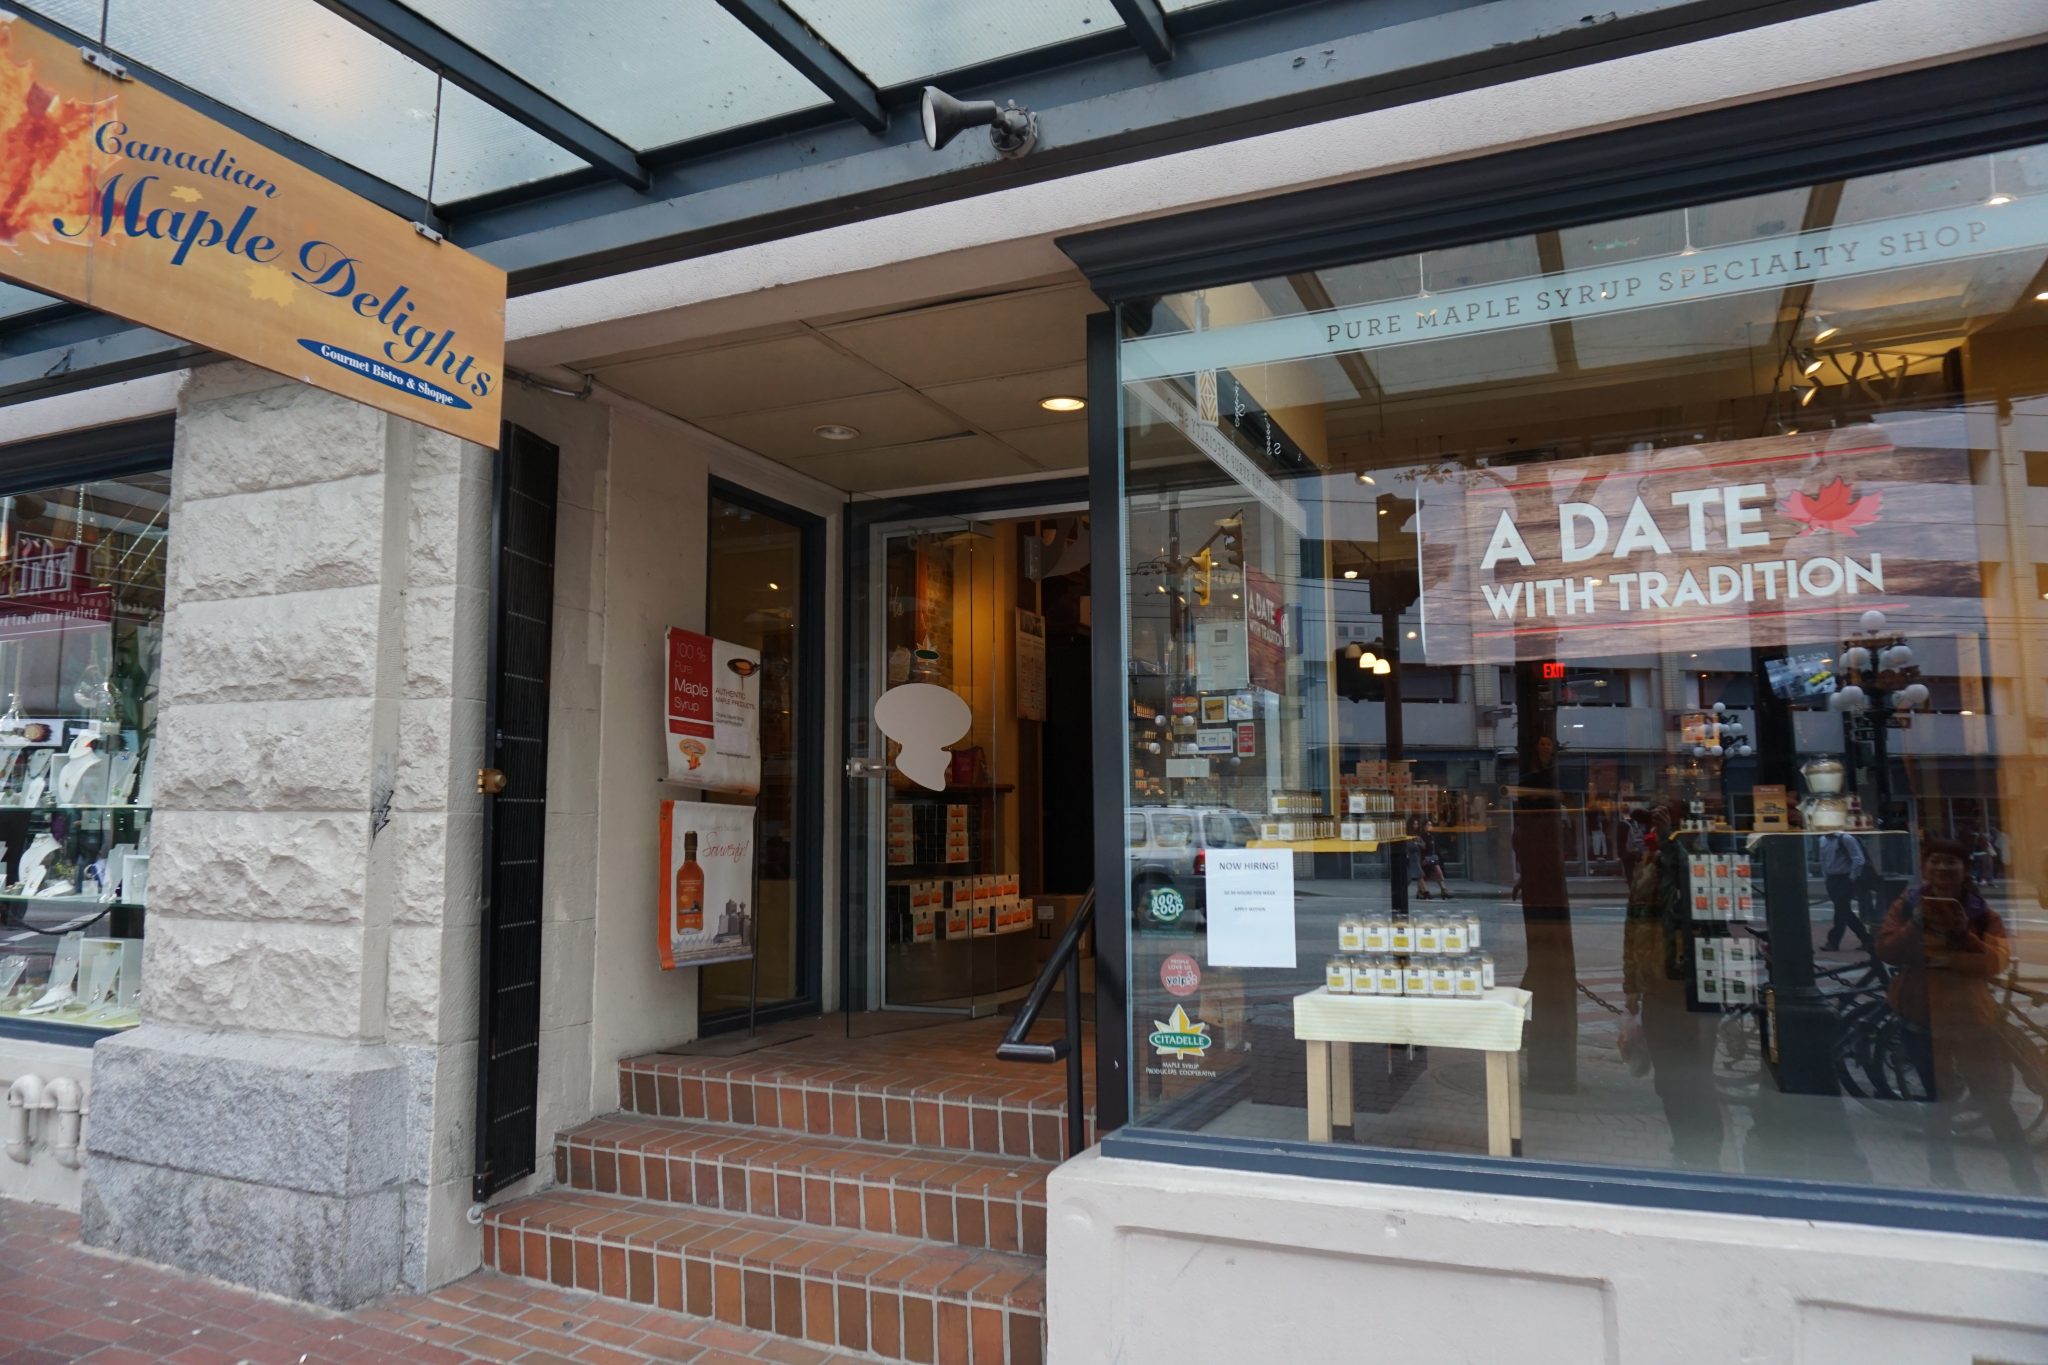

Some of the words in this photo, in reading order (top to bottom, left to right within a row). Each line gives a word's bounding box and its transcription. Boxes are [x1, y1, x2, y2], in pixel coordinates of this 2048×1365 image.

[95, 120, 282, 199] Canadian
[52, 172, 284, 266] Maple
[1327, 314, 1402, 343] PURE
[1415, 296, 1521, 330] MAPLE
[1536, 277, 1643, 312] SYRUP
[1658, 241, 1860, 292] SPECIALTY
[1879, 220, 1987, 257] SHOP
[290, 240, 498, 398] Delights
[320, 344, 370, 373] Gourmet
[372, 364, 404, 386] Bistro
[406, 377, 417, 390] &
[418, 381, 454, 405] Shoppe
[1480, 509, 1536, 570] A
[1559, 483, 1771, 563] DATE
[1480, 576, 1596, 620] WITH
[1609, 552, 1886, 611] TRADITION
[1256, 592, 1275, 625] DATE
[676, 642, 695, 660] 100
[674, 660, 694, 675] Pure
[1543, 663, 1566, 679] EXIT
[674, 677, 708, 698] Maple
[715, 687, 746, 701] AUTHENTIC
[674, 696, 700, 712] Syrup
[1219, 862, 1242, 870] NOW
[1244, 862, 1279, 871] HIRING!
[1152, 893, 1183, 907] 100%
[1154, 1035, 1205, 1046] CITADELLE
[1179, 1069, 1217, 1078] COOPERATIVE
[1181, 1062, 1200, 1070] SYRUP
